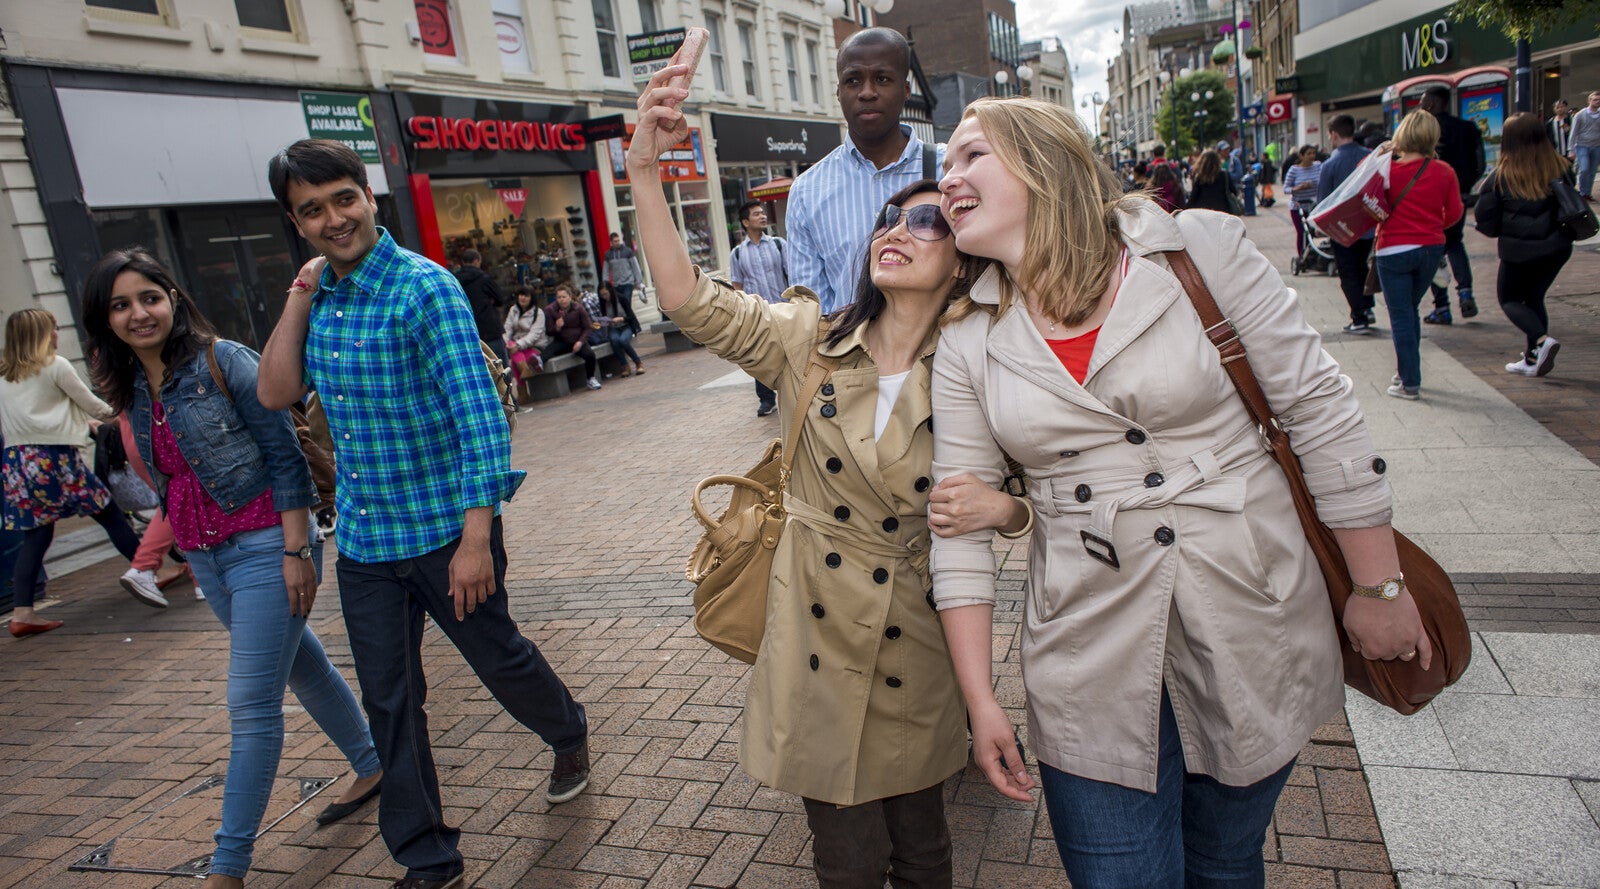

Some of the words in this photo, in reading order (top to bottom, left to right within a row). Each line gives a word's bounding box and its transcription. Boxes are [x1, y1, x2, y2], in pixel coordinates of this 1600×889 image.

[1402, 19, 1449, 72] M&S
[631, 49, 649, 60] SHOP
[651, 47, 661, 56] TO
[662, 45, 675, 55] LET
[633, 65, 647, 75] 020
[308, 105, 330, 115] SHOP
[332, 106, 357, 116] LEASE
[311, 119, 363, 131] AVAILABLE
[409, 116, 586, 150] SHOEHOLICS
[357, 140, 376, 150] 2000
[766, 136, 807, 154] Superdrug
[503, 190, 526, 201] SALE
